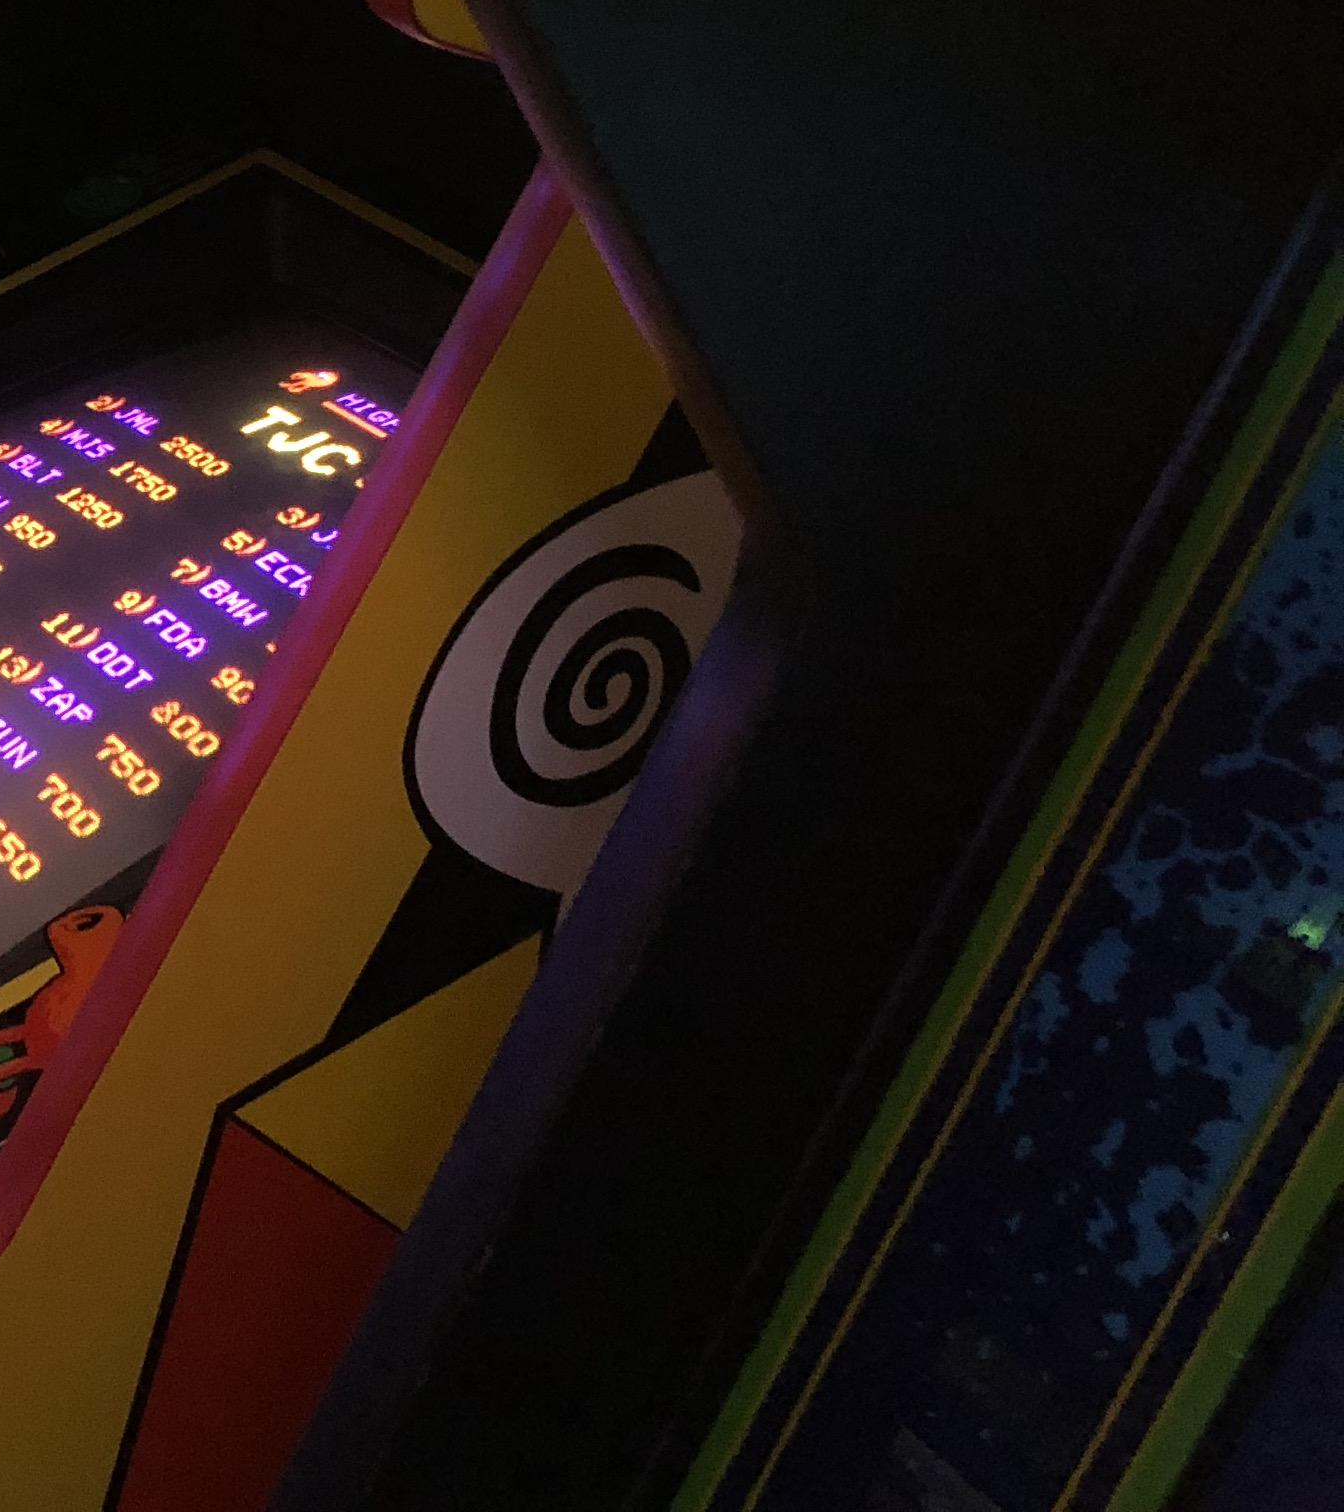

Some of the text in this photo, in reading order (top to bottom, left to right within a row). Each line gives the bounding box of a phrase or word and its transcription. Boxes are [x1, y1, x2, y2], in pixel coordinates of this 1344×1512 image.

[60, 428, 116, 459] MJS
[109, 460, 178, 502] 1750
[160, 436, 231, 477] 2500
[240, 405, 362, 474] TJC
[7, 453, 63, 484] BLT
[56, 487, 124, 530] 1250
[5, 512, 57, 550] 950
[198, 578, 269, 629] BMW
[29, 675, 97, 724] ZAP
[95, 732, 161, 796] 750
[149, 700, 221, 757] 800
[36, 772, 103, 839] 700
